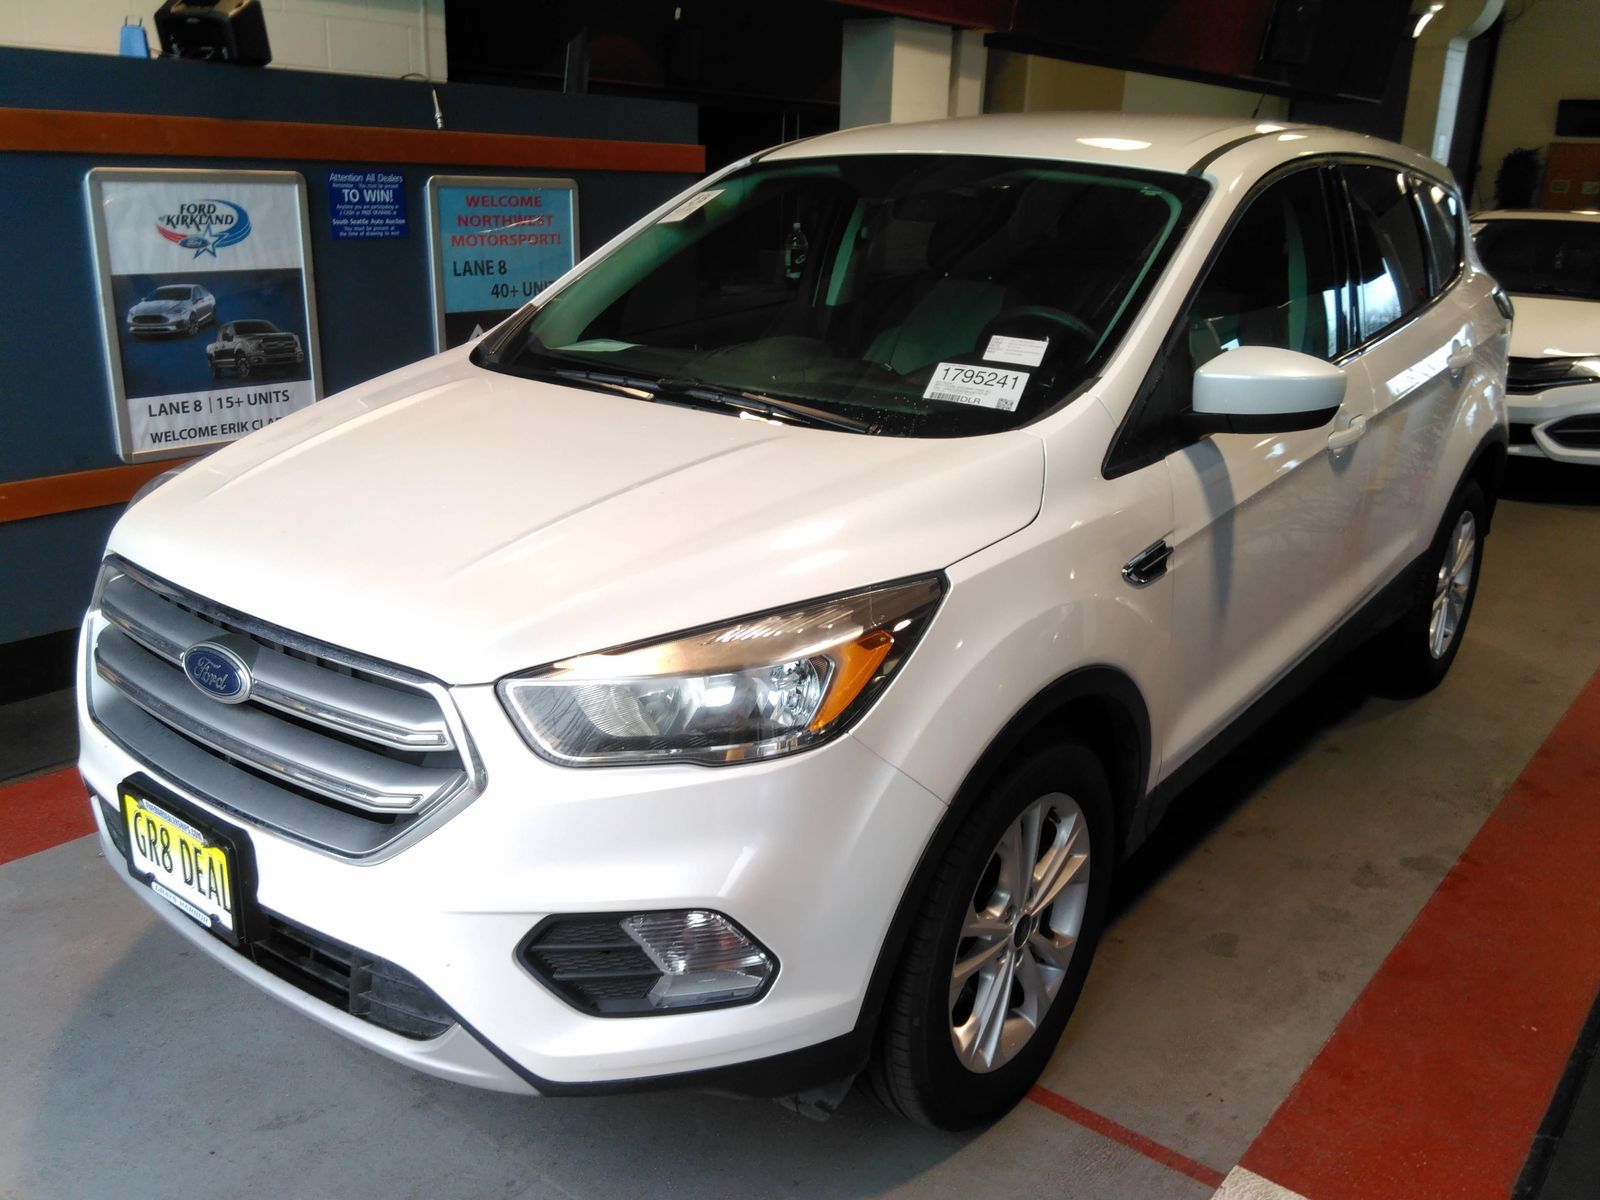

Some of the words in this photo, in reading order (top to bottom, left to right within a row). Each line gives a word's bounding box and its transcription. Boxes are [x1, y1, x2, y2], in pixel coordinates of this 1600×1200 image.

[329, 172, 363, 182] Attention
[366, 173, 376, 182] All
[377, 173, 403, 183] Dealers
[342, 189, 360, 202] TO
[363, 189, 394, 203] WIN!
[465, 195, 542, 208] WELCOME
[180, 203, 217, 217] FORD
[166, 214, 234, 232] KIRKLAND
[457, 214, 554, 228] NORTHWEST
[451, 233, 561, 247] MOTORSPORT!
[453, 260, 494, 277] LANE
[498, 260, 507, 275] 8
[491, 283, 519, 299] 40+
[522, 280, 556, 297] UNI
[942, 367, 1019, 391] 1795241
[148, 401, 190, 417] LANE
[193, 400, 203, 412] 8
[217, 396, 244, 409] 15+
[247, 390, 290, 406] UNITS
[961, 395, 982, 405] DLR
[150, 425, 217, 444] WELCOME
[221, 421, 249, 435] ERIK
[194, 656, 229, 691] Ford
[134, 811, 174, 874] GR8
[179, 837, 232, 914] DEAL
